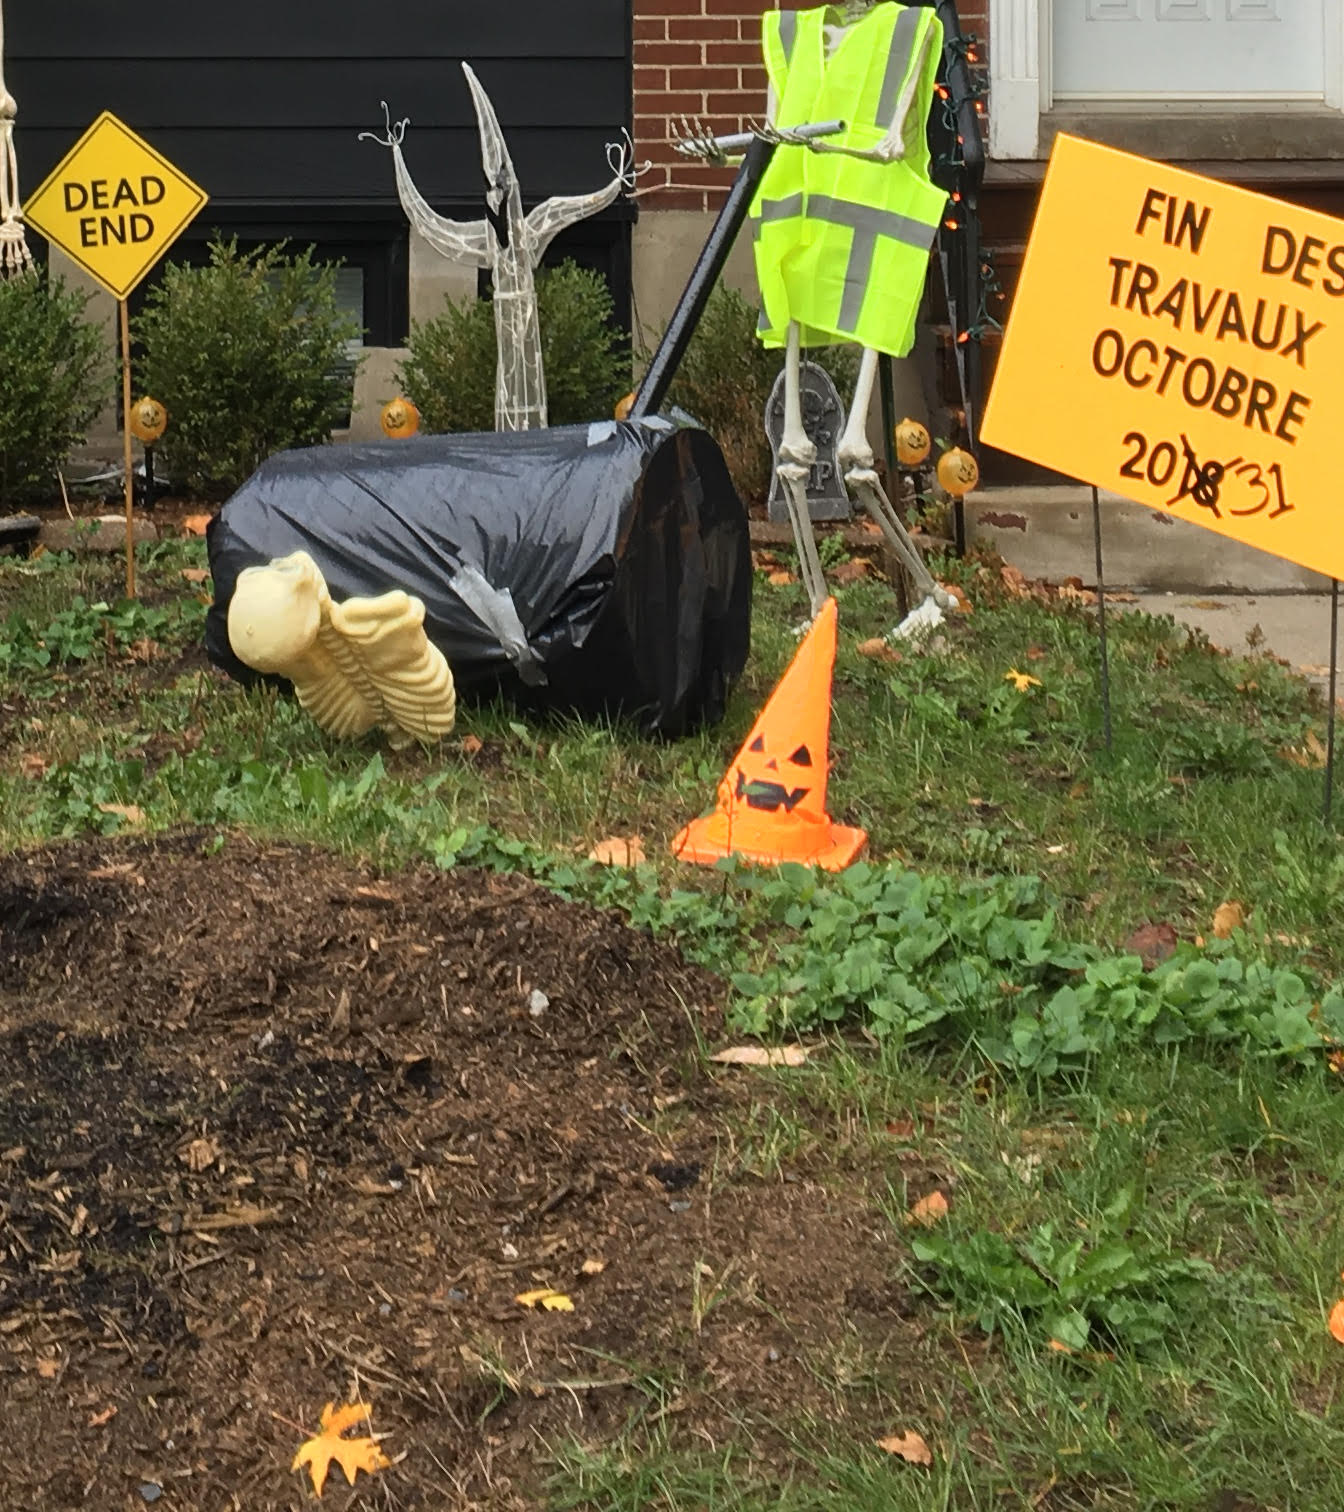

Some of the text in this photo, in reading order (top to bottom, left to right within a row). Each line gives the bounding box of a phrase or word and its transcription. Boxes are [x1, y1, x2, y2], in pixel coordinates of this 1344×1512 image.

[63, 175, 166, 212] DEAD
[1134, 187, 1214, 255] FIN
[79, 213, 155, 248] END
[1108, 256, 1328, 367] TRAVAUX
[1092, 328, 1312, 447] OCTOBRE
